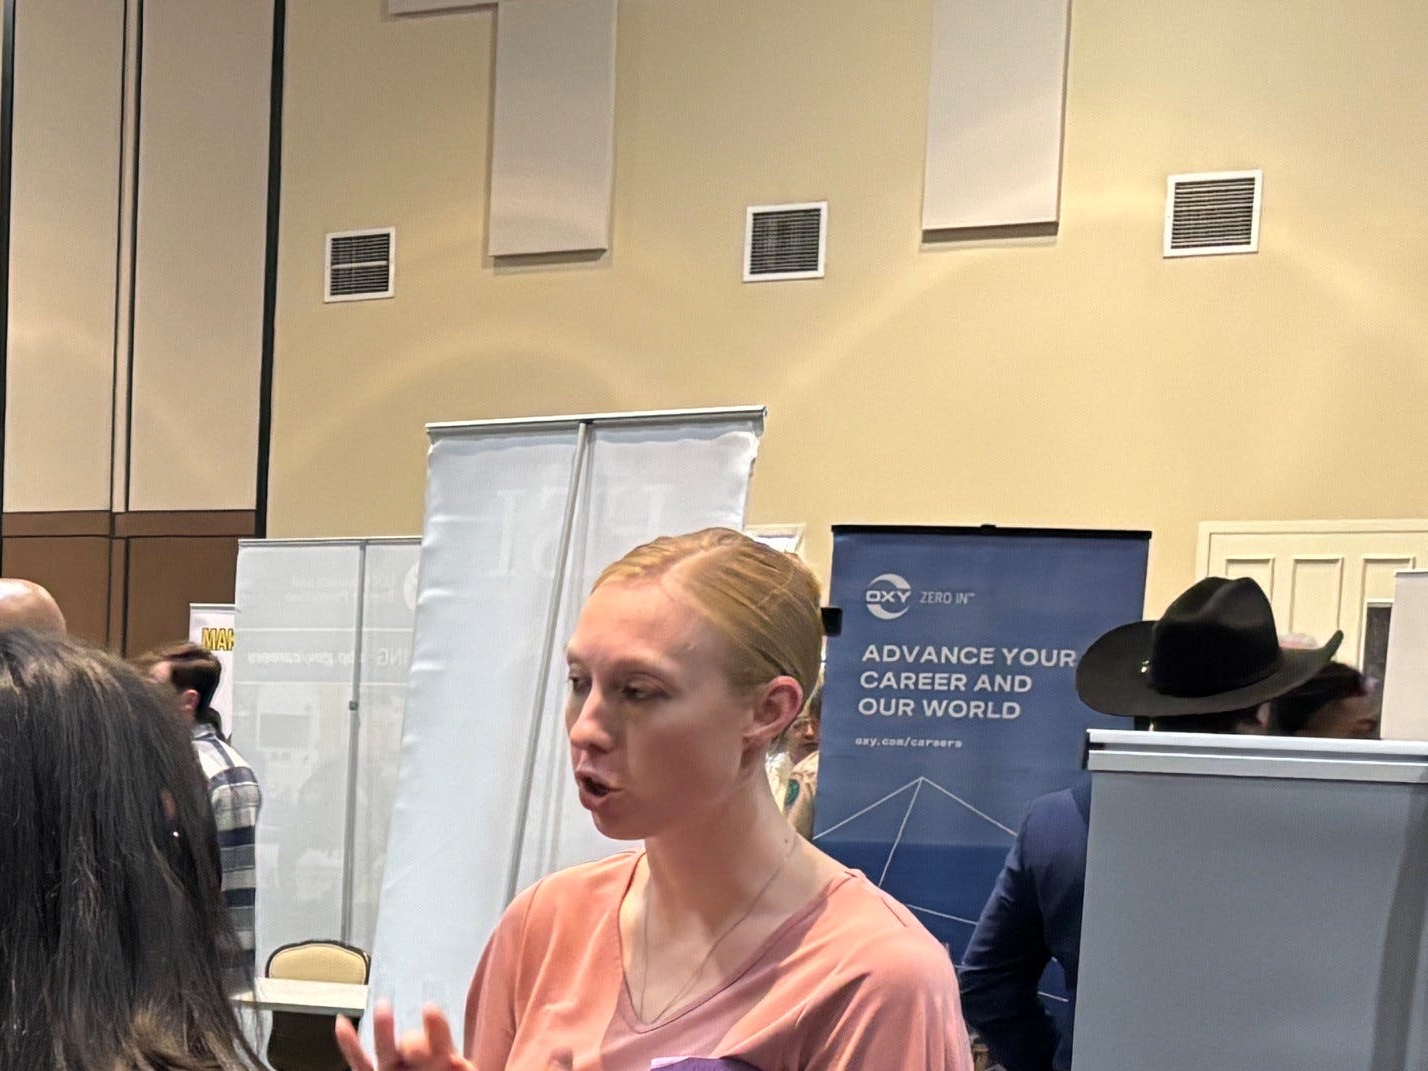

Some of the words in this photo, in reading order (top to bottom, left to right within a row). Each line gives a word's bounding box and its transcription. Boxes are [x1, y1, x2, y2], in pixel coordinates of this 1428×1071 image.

[865, 590, 911, 603] OXY
[920, 591, 952, 604] ZERO
[862, 644, 995, 665] ADVANCE
[1002, 648, 1076, 667] YOUR
[860, 671, 967, 691] CAREER
[974, 675, 1033, 693] AND
[858, 698, 915, 717] OUR
[923, 699, 1021, 719] WORLD
[855, 736, 963, 748] oxy.com/careers
